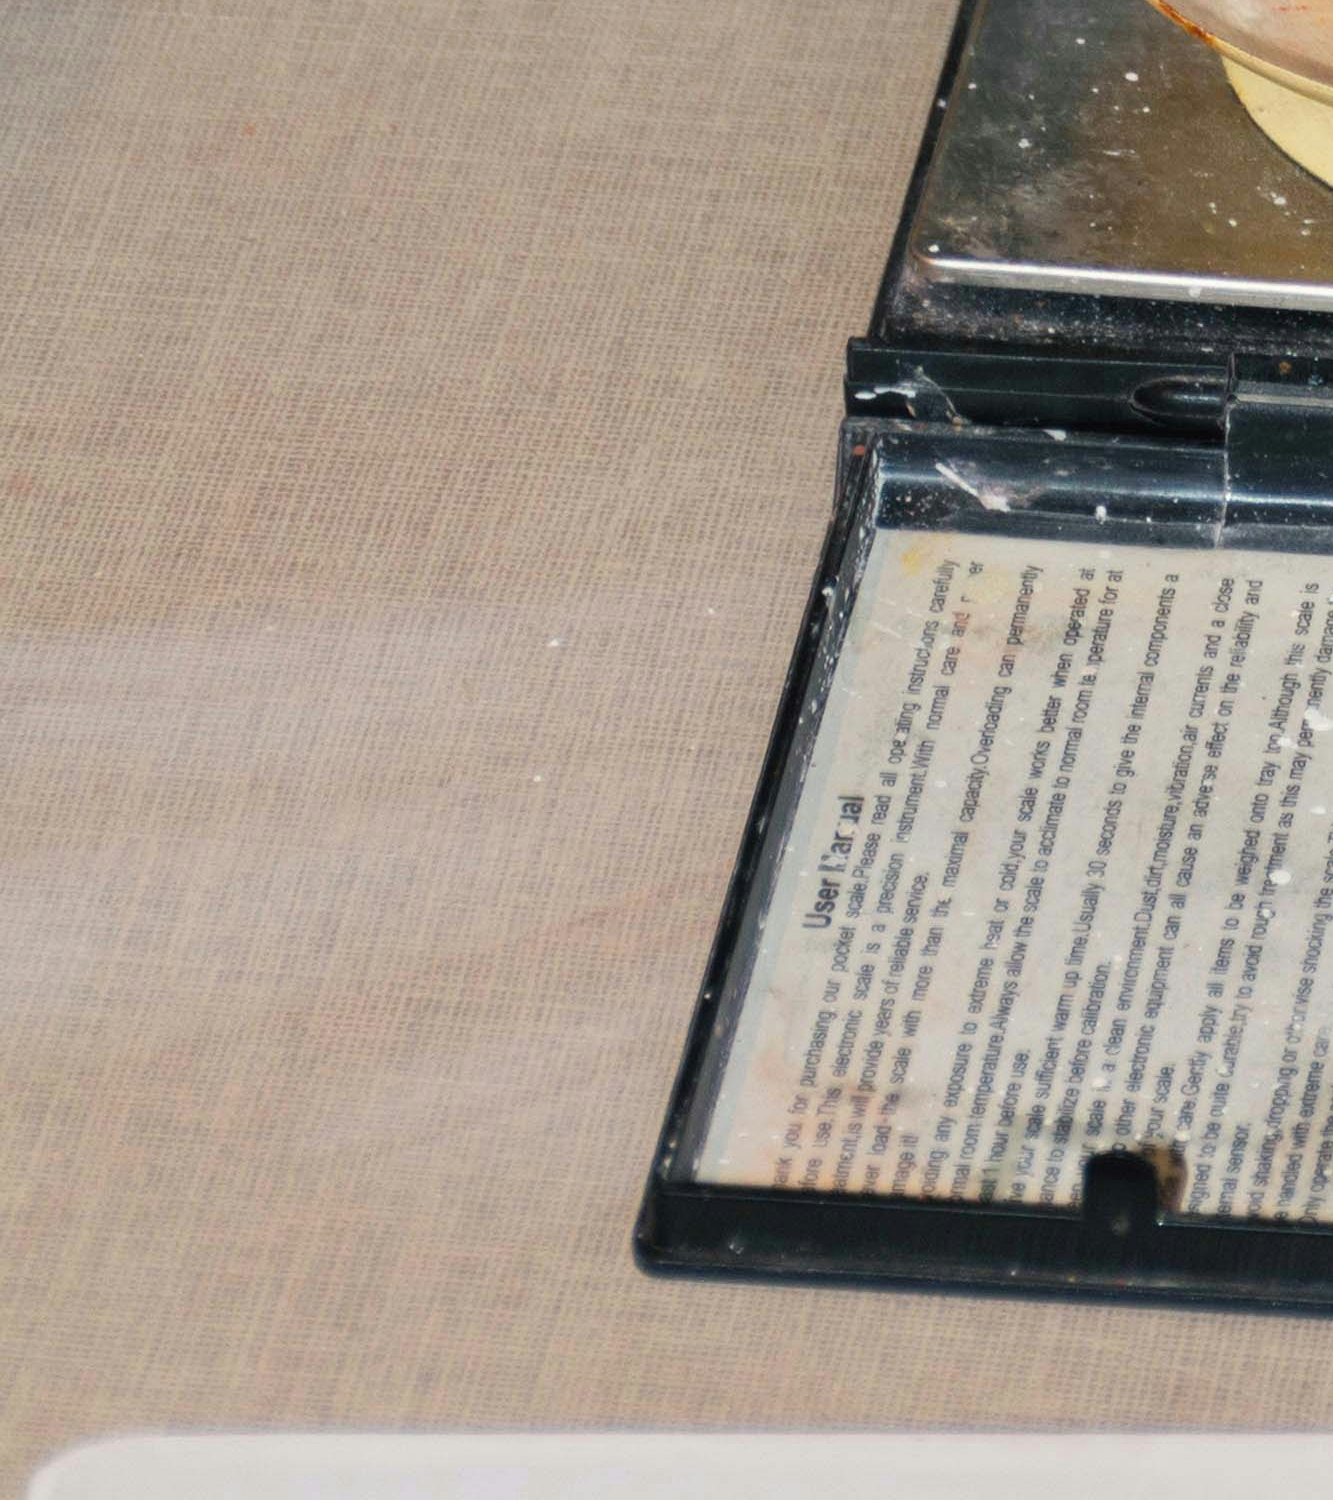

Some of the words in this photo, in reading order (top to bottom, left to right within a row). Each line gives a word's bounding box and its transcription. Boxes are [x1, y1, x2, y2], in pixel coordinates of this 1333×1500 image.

[928, 559, 959, 613] carefully
[1005, 565, 1042, 645] permanently
[1062, 587, 1093, 645] operated
[1294, 600, 1315, 635] scale
[1142, 587, 1178, 666] components
[1051, 653, 1072, 687] when
[1220, 672, 1240, 693] the
[1129, 671, 1154, 719] internal
[1217, 699, 1234, 716] on
[1037, 695, 1061, 733] better
[1121, 723, 1141, 744] the
[1205, 722, 1228, 758] effect
[1027, 740, 1050, 779] works
[1114, 749, 1137, 777] give
[1256, 761, 1280, 786] tray
[1289, 751, 1312, 780] may
[879, 771, 897, 787] all
[1280, 784, 1300, 807] this
[870, 794, 891, 824] read
[1016, 786, 1038, 821] scale
[1249, 792, 1269, 823] onto
[1278, 812, 1294, 828] as
[1005, 941, 1027, 977] allow
[1022, 876, 1044, 912] scale
[1036, 792, 1066, 856] acclimate
[1058, 727, 1082, 772] normal
[1072, 689, 1092, 723] room
[1095, 799, 1122, 855] seconds
[1187, 823, 1203, 840] an
[831, 1010, 862, 1076] electronic
[852, 963, 874, 999] scale
[876, 852, 908, 913] precision
[926, 685, 950, 729] normal
[941, 646, 960, 676] care
[941, 830, 968, 887] maximal
[1084, 1099, 1106, 1136] scale
[1187, 665, 1213, 718] currents
[1202, 634, 1221, 658] and
[1213, 577, 1234, 613] close
[1087, 859, 1107, 876] 30
[1176, 846, 1198, 887] cause
[1234, 829, 1263, 885] weighed
[803, 880, 839, 928] User
[1169, 893, 1186, 909] all
[1313, 887, 1333, 908] the
[921, 926, 943, 956] than
[1163, 915, 1180, 940] can
[1300, 913, 1333, 973] shocking
[829, 926, 858, 971] pocket
[888, 927, 913, 976] reliable
[1211, 937, 1235, 974] items
[1241, 944, 1263, 981] avoid
[822, 979, 840, 1002] our
[882, 980, 899, 994] of
[912, 965, 933, 1001] more
[966, 957, 993, 1013] extreme
[1063, 970, 1082, 988] up
[1142, 946, 1176, 1018] equipment
[1206, 981, 1223, 997] all
[874, 997, 898, 1035] years
[901, 1009, 921, 1037] with
[1052, 993, 1071, 1031] warm
[798, 1010, 836, 1086] purchasing
[857, 1040, 887, 1092] provide
[888, 1046, 911, 1083] scale
[1066, 1038, 1091, 1083] before
[1124, 1025, 1154, 1092] electronic
[943, 1043, 975, 1107] exposure
[1033, 1036, 1061, 1098] sufficient
[996, 1082, 1021, 1127] before
[1297, 1061, 1323, 1117] extreme
[934, 1115, 956, 1141] any
[1114, 1098, 1135, 1135] other
[1290, 1121, 1309, 1149] with
[987, 1131, 1008, 1162] hour
